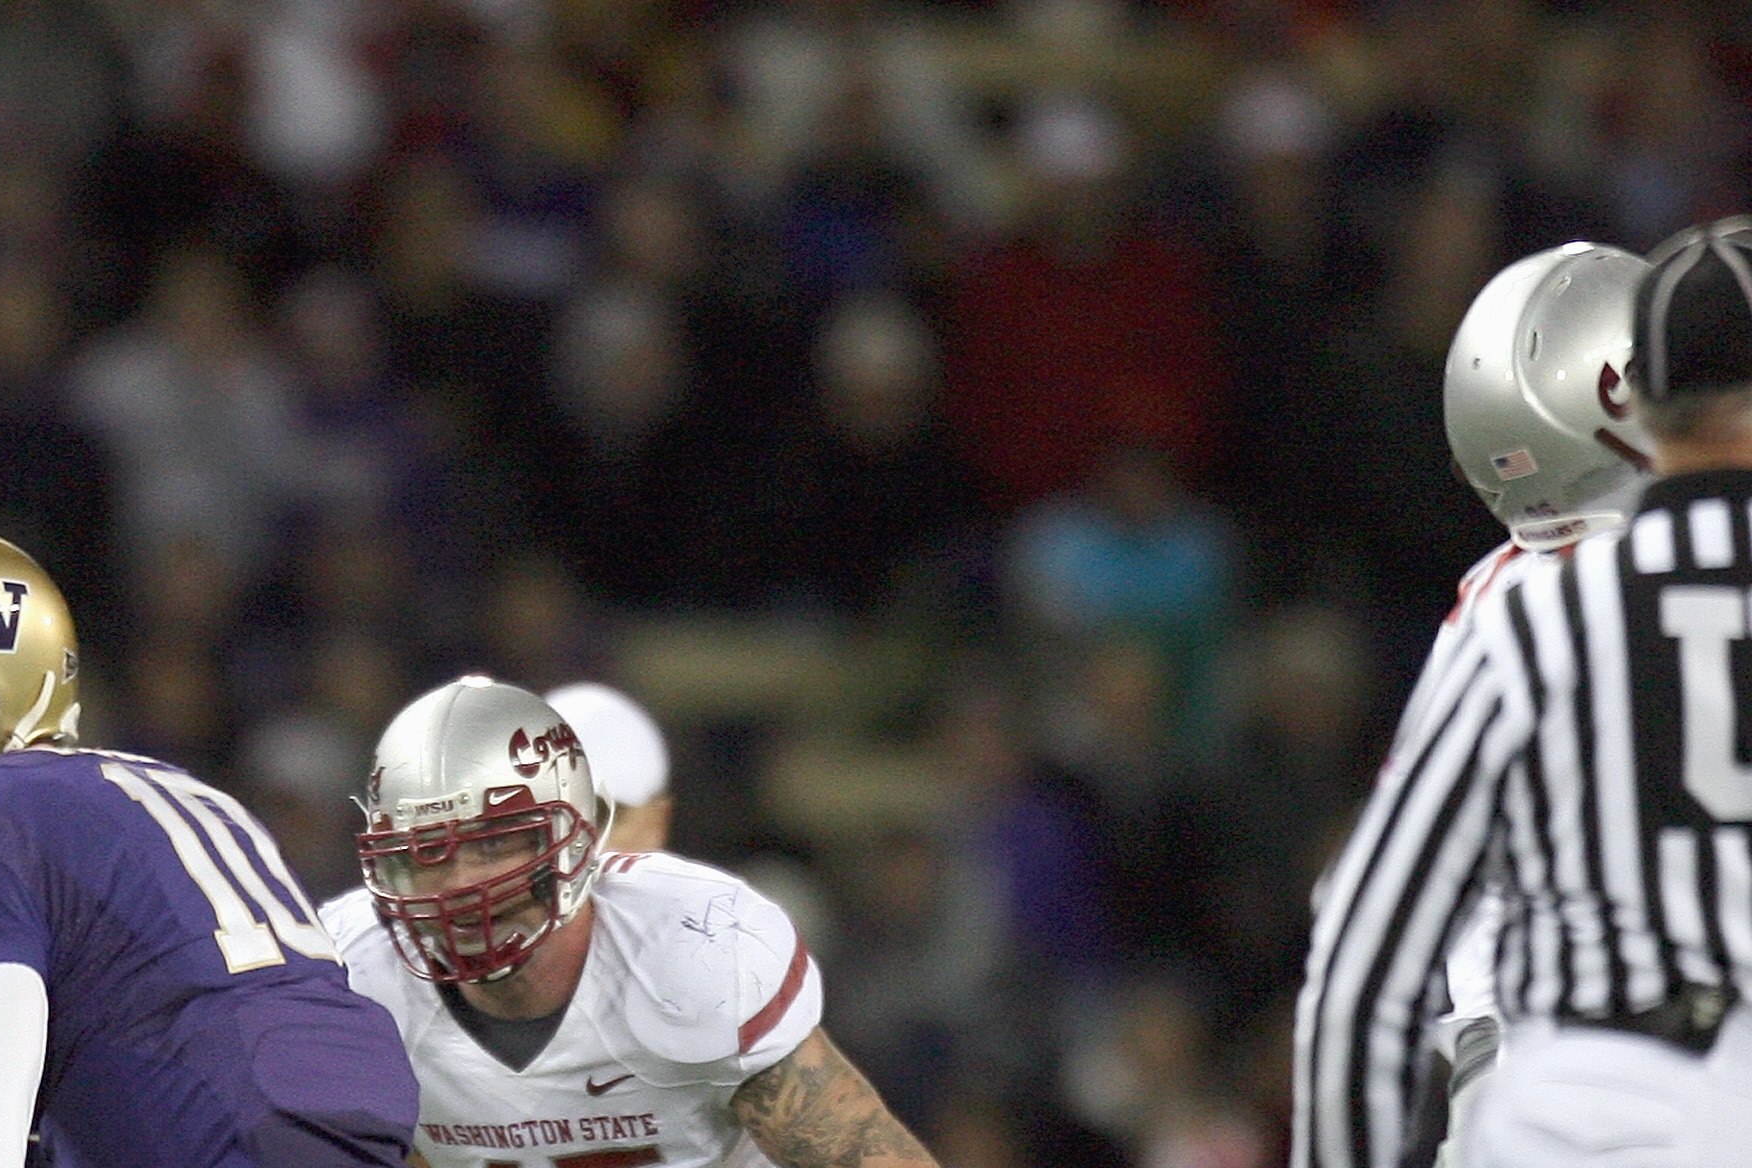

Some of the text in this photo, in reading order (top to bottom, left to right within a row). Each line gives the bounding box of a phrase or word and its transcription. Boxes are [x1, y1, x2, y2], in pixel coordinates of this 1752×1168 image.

[414, 800, 454, 818] WSU
[100, 762, 344, 974] 10
[418, 1113, 660, 1149] WASHINGTON STATE
